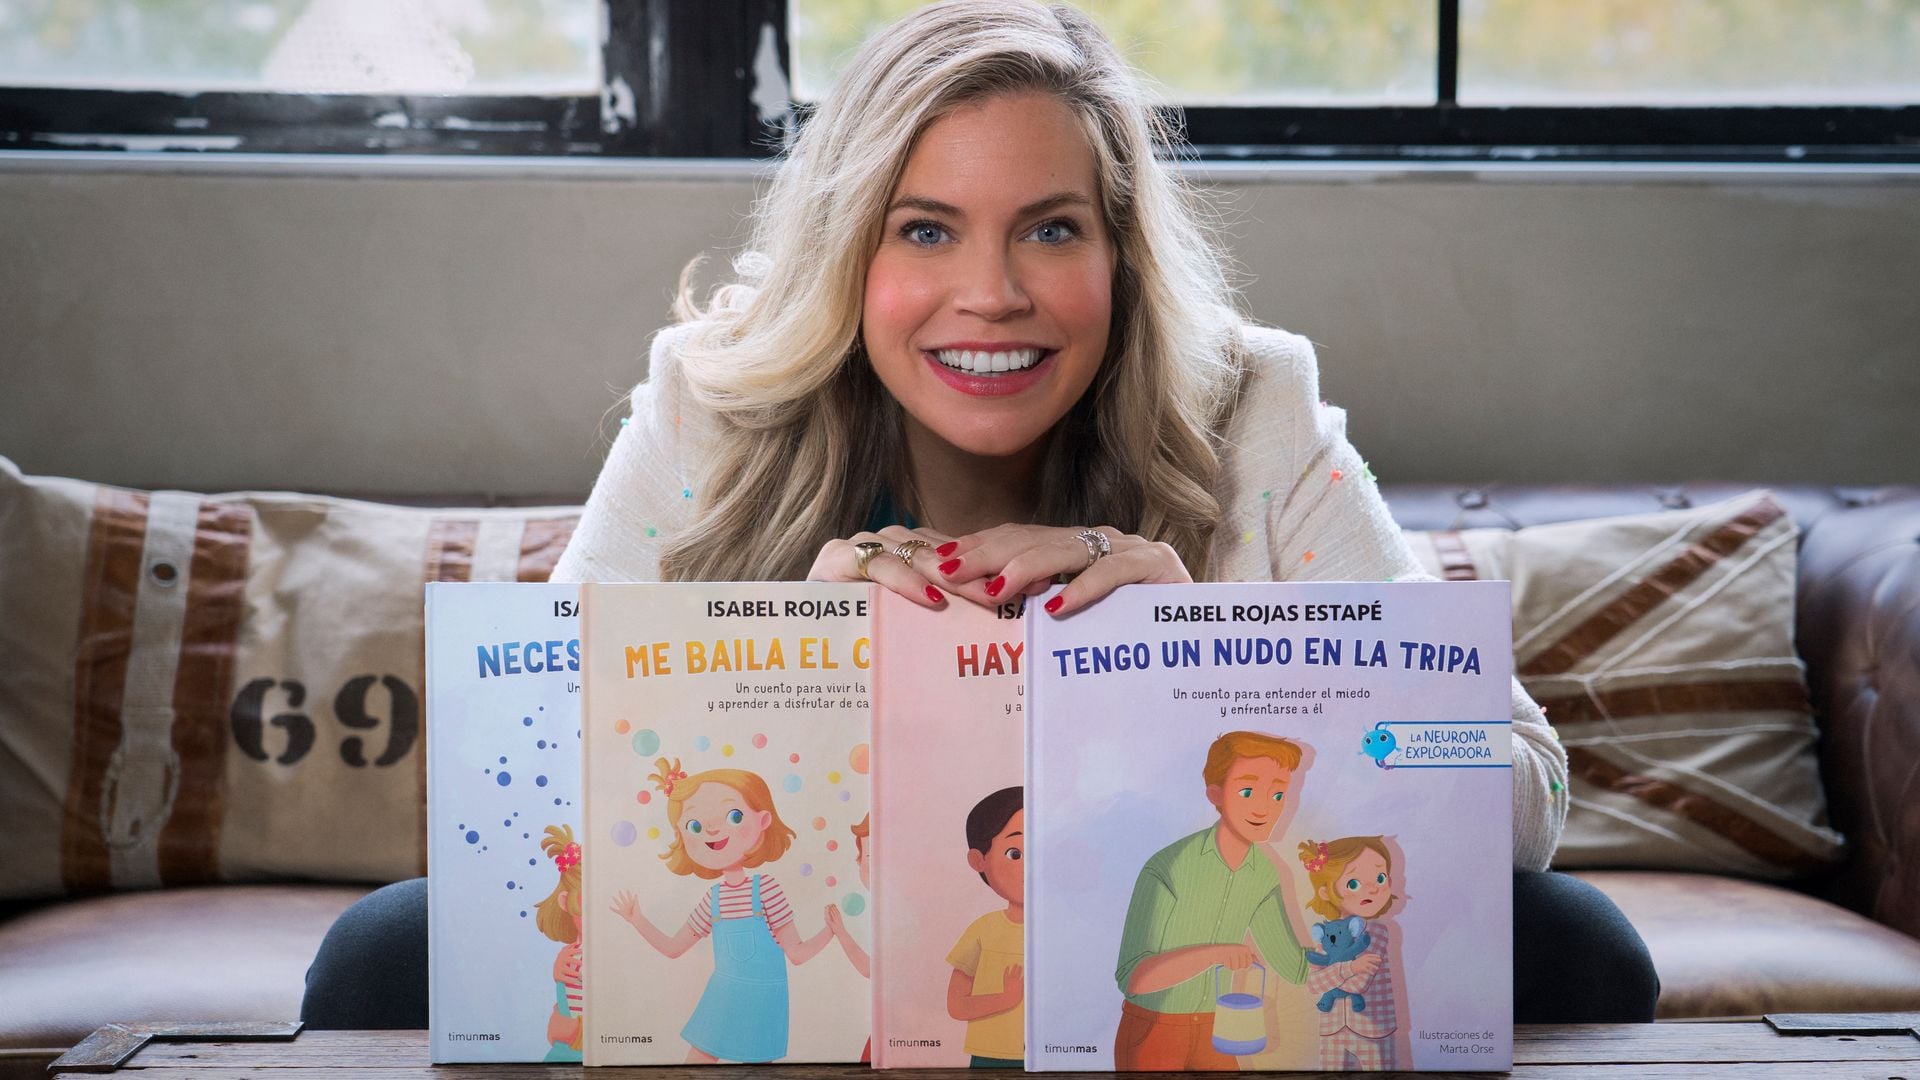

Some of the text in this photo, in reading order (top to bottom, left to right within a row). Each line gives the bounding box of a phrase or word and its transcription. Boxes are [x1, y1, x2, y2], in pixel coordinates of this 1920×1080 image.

[707, 600, 779, 617] ISABEL
[784, 600, 851, 620] ROJAS
[1154, 599, 1382, 625] ISABEL ROJAS ESTAPÉ
[476, 639, 580, 679] NECES
[624, 641, 672, 679] ME
[685, 637, 786, 675] BAILA
[799, 636, 839, 670] EL
[956, 641, 1024, 678] HAY
[1052, 637, 1481, 677] TENGO UN NUDO EN LA TRIPA
[735, 682, 866, 698] Un cuento para vivir la
[1173, 687, 1371, 703] Un cuento para entender el miedo
[707, 701, 714, 713] y
[718, 698, 769, 713] aprender
[773, 700, 780, 709] a
[784, 697, 836, 710] disfrutar
[839, 697, 853, 709] de
[1005, 703, 1012, 715] y
[1220, 700, 1323, 717] y enfrentarse a él
[230, 674, 419, 767] 69
[1410, 729, 1488, 744] LA NEURONA
[1405, 745, 1492, 760] EXPLORADORA
[448, 1032, 501, 1042] timunmas
[600, 1034, 653, 1044] timunmas
[889, 1037, 942, 1048] timunmas
[1419, 1030, 1495, 1040] Ilustraciones de
[1044, 1043, 1098, 1054] timunmas
[1439, 1044, 1495, 1054] Marta Orse
